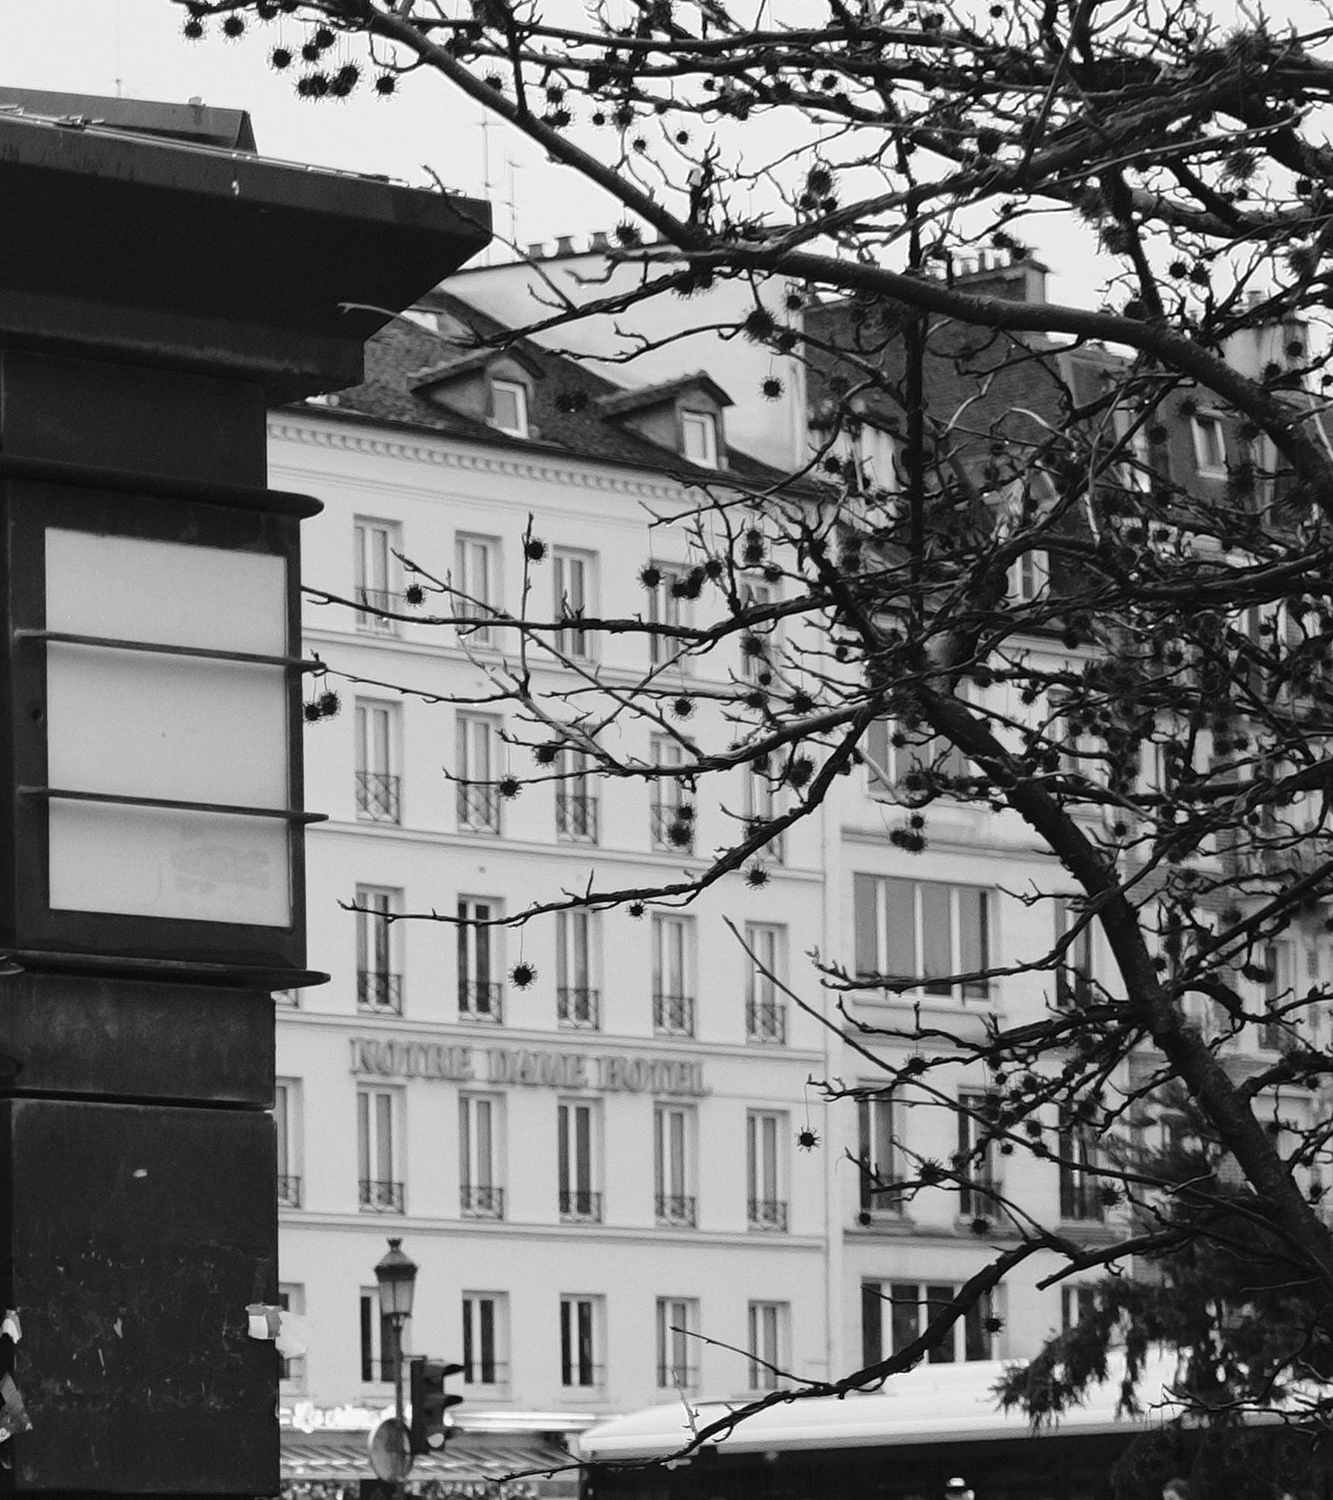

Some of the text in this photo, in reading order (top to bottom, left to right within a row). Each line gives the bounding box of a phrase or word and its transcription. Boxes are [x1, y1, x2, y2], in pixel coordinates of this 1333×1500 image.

[349, 1037, 713, 1097] NOTRE DAME HOTEL
